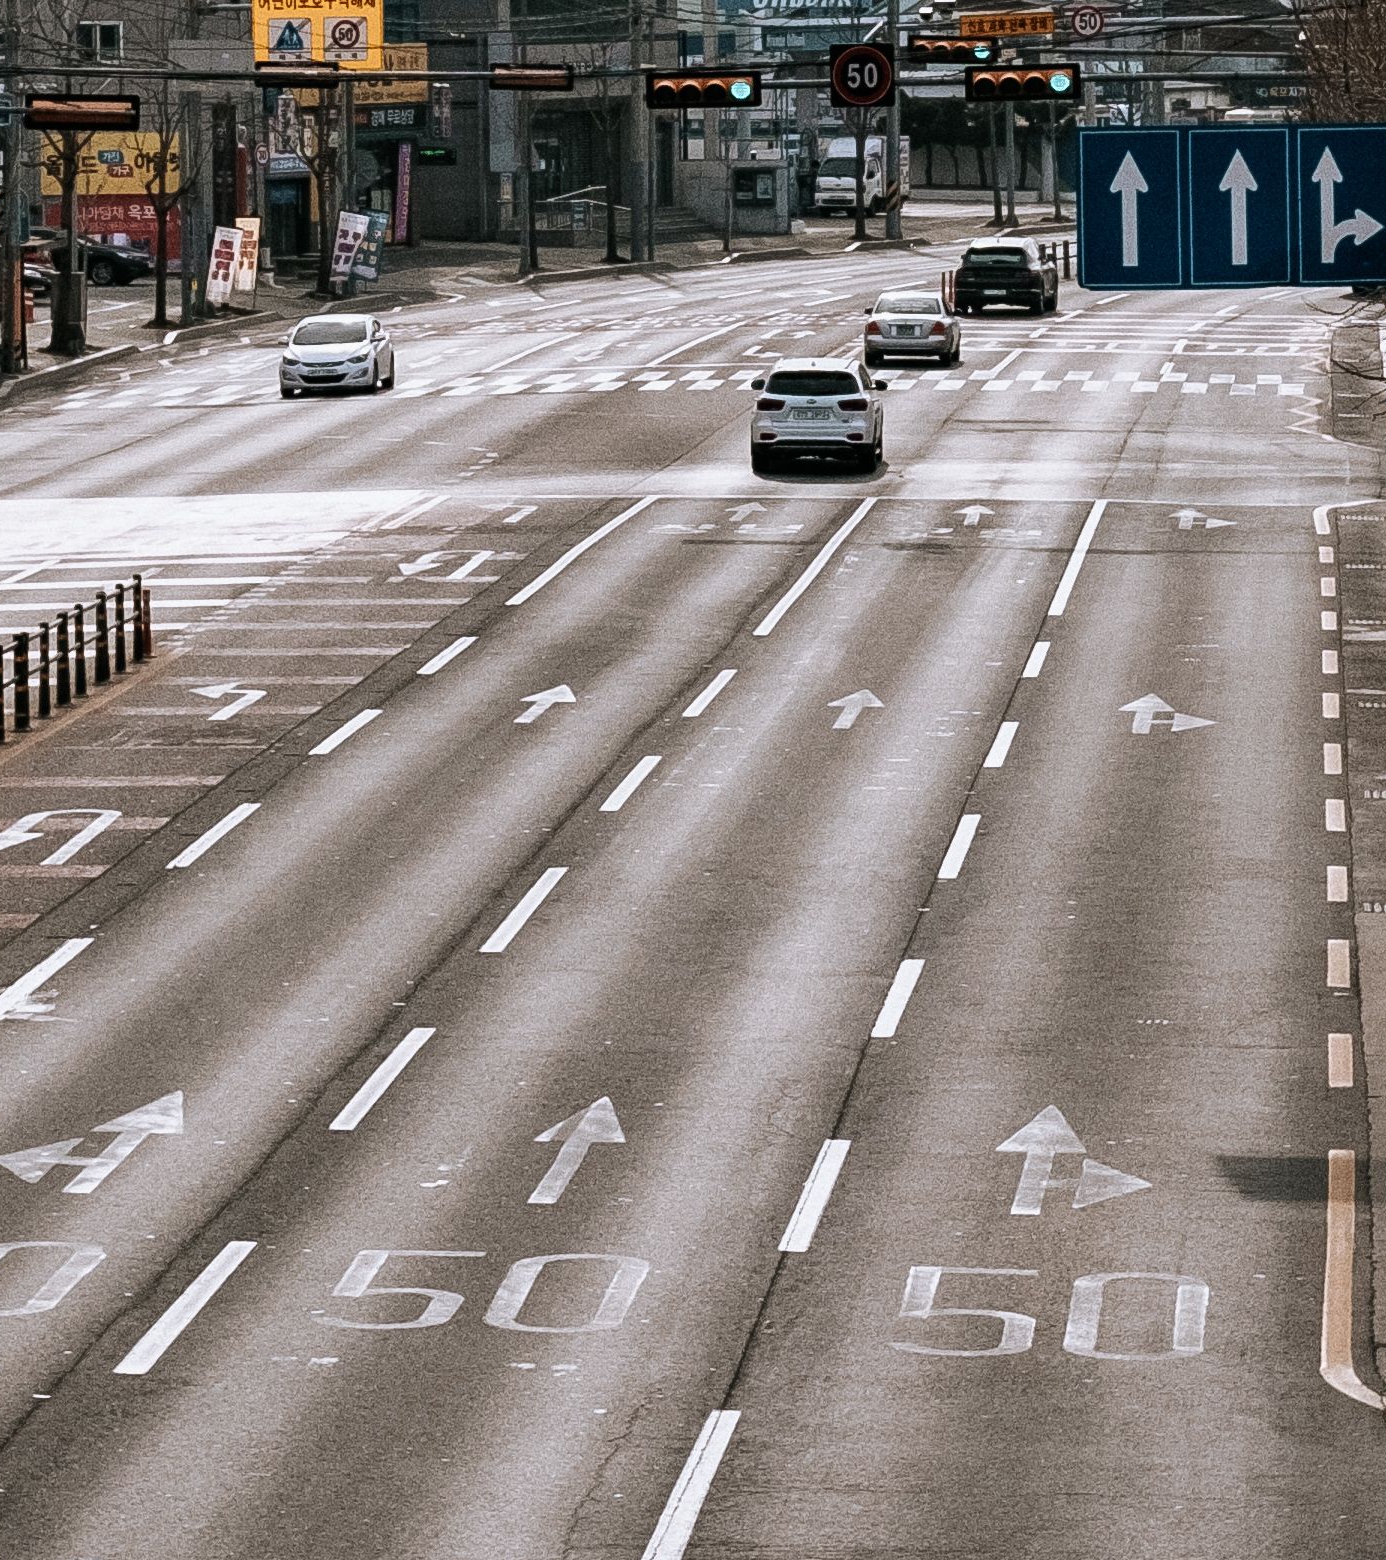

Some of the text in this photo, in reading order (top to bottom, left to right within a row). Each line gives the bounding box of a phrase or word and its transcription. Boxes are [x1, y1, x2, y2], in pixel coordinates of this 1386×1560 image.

[1078, 15, 1099, 30] 50
[847, 63, 878, 88] 50
[127, 204, 170, 222] 옥포
[313, 1248, 652, 1334] 50
[890, 1264, 1210, 1362] 50
